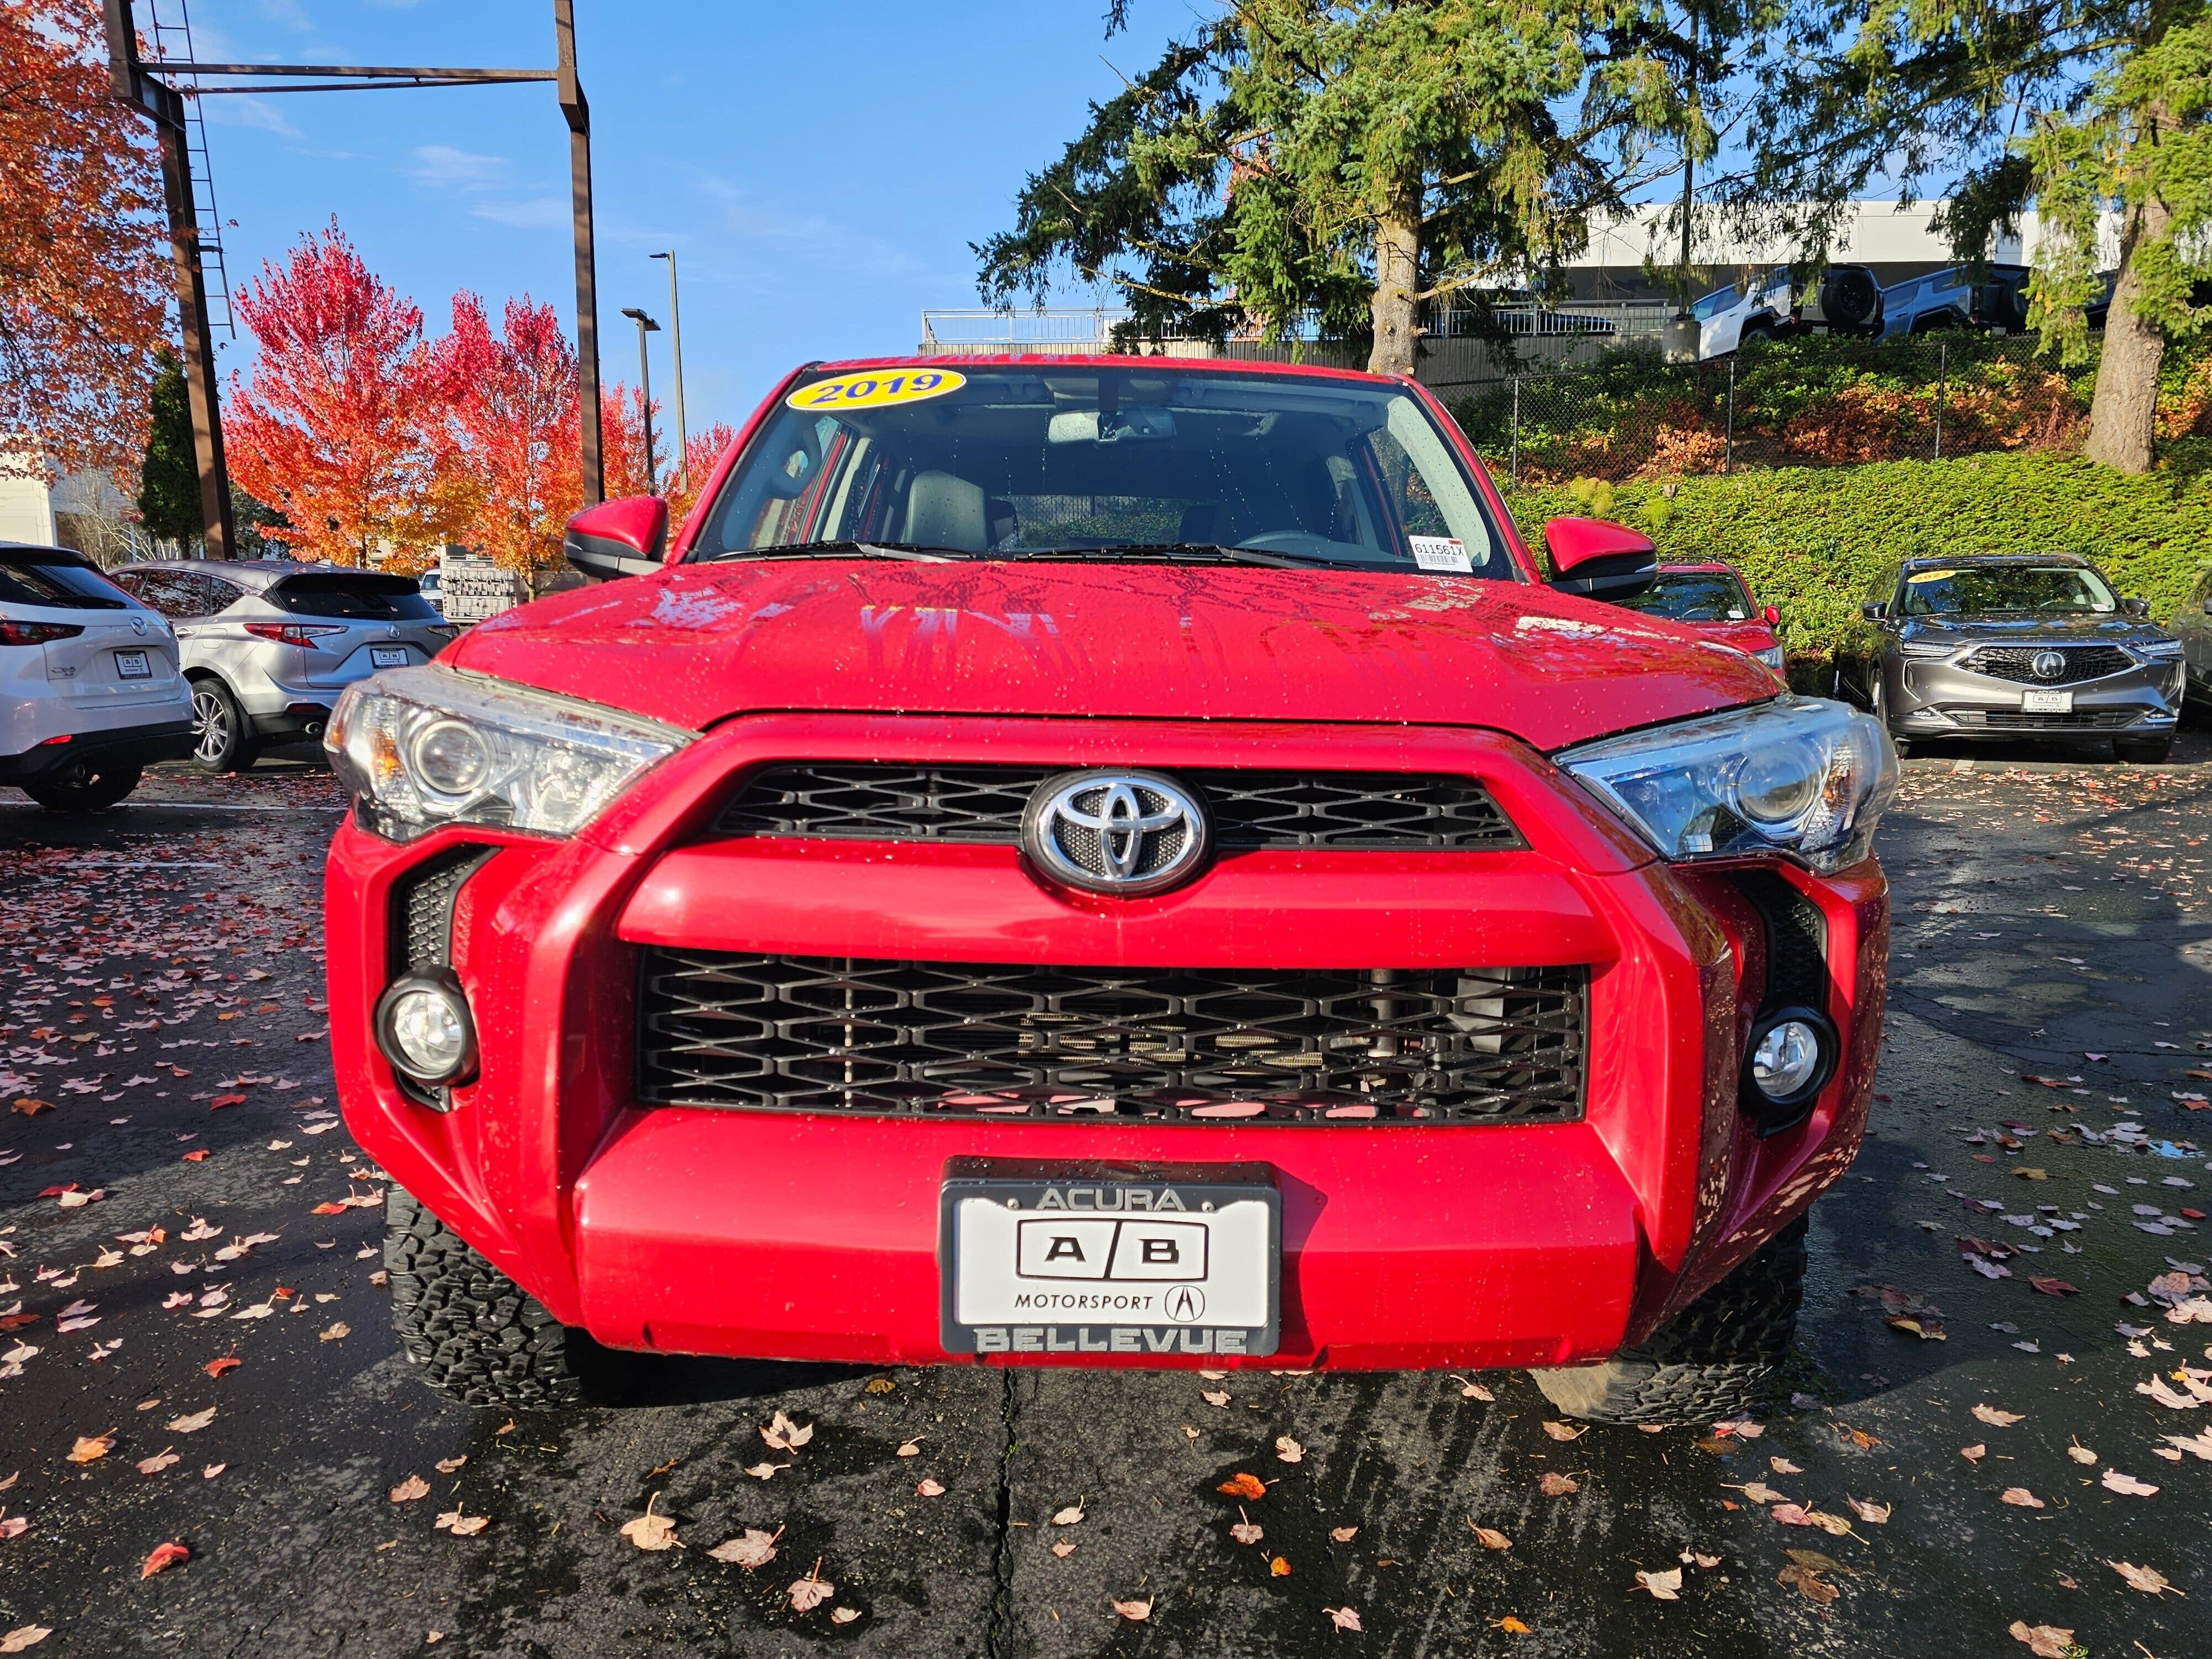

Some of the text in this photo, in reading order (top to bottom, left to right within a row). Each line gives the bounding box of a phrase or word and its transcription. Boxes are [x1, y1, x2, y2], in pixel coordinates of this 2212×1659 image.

[808, 374, 943, 405] 2019
[1415, 544, 1464, 556] 611561X
[1036, 1188, 1187, 1212] ACURA
[1044, 1237, 1180, 1265] A B
[1014, 1293, 1154, 1311] MOTORSPORT
[973, 1328, 1248, 1354] BELLEVUE
